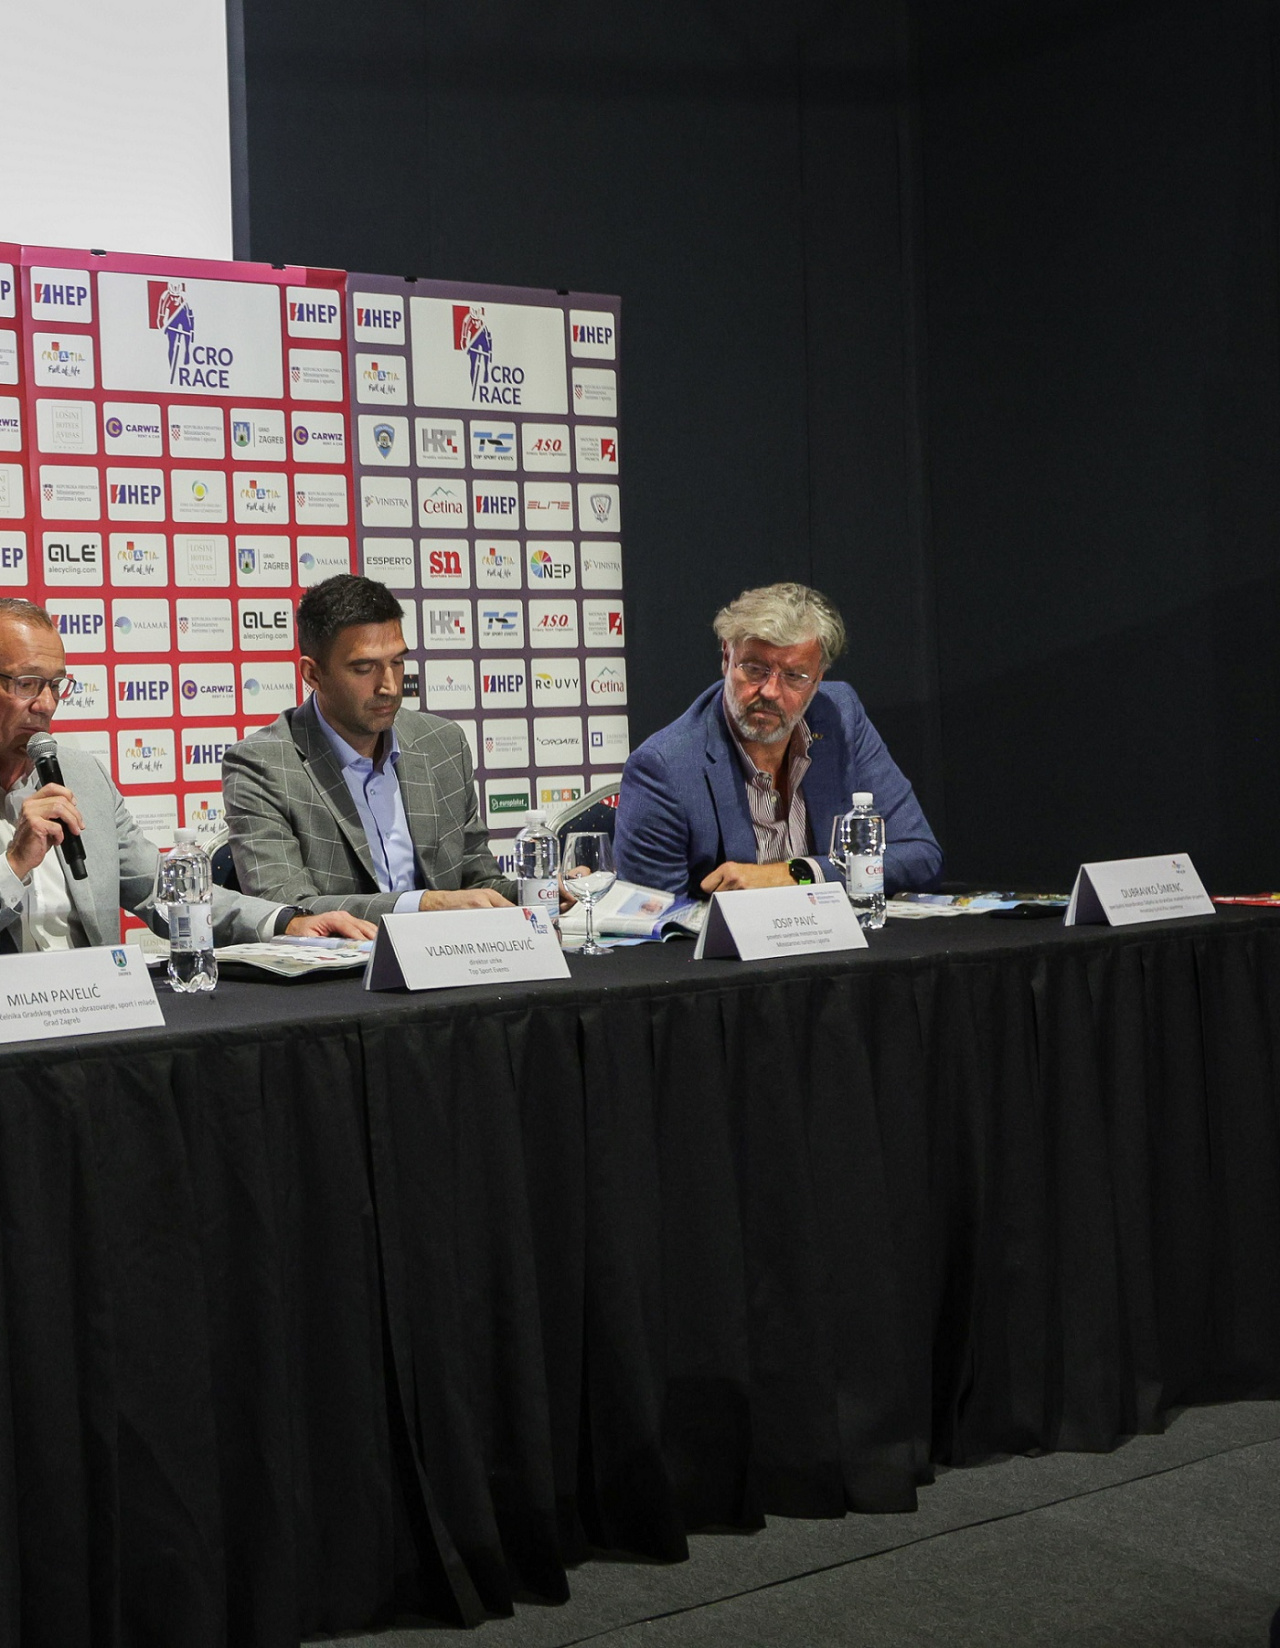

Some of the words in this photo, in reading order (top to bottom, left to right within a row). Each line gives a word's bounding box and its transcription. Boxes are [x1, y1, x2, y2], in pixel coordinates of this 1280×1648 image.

[53, 285, 87, 306] HEP
[306, 304, 337, 323] HEP
[372, 310, 401, 329] HEP
[587, 326, 612, 344] HEP
[193, 346, 233, 366] CRO
[179, 368, 229, 388] RACE
[491, 366, 524, 384] CRO
[480, 386, 521, 405] RACE
[126, 424, 159, 433] CARWIZ
[259, 436, 284, 444] ZAGREB
[128, 485, 161, 504] HEP
[424, 499, 462, 514] Cetina
[490, 496, 516, 514] HEP
[48, 566, 96, 574] alecycling.com
[264, 562, 289, 570] ZAGREB
[366, 557, 412, 565] ESSPERTO
[69, 615, 103, 634] HEP
[136, 681, 169, 700] HEP
[498, 675, 523, 692] HEP
[591, 680, 624, 693] Cetina
[425, 944, 476, 956] VLADIMIR
[476, 937, 534, 953] MIHOLJEVIĆ
[7, 992, 48, 1006] MILAN
[51, 984, 100, 1002] PAVELIĆ
[59, 1017, 81, 1025] Zagreb
